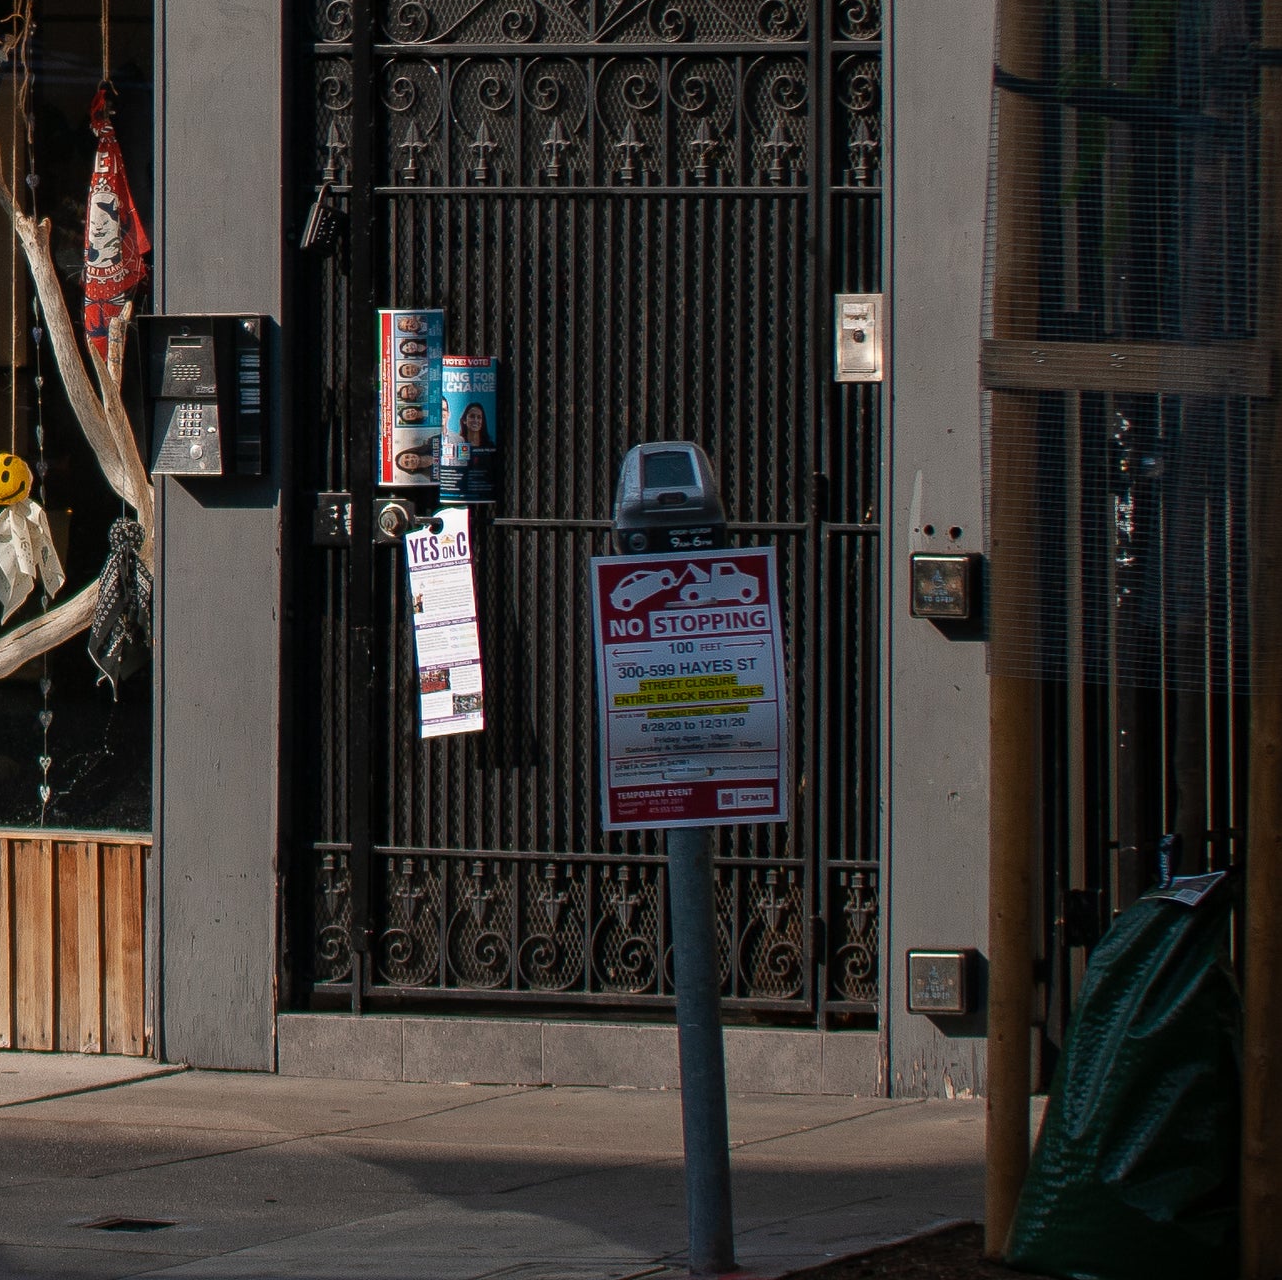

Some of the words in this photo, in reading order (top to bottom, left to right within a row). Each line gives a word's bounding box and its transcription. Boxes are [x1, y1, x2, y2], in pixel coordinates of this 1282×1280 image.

[473, 372, 495, 382] FOR
[446, 382, 496, 392] CHANGE
[409, 535, 439, 563] YES
[442, 545, 455, 559] ON
[456, 531, 467, 556] C
[609, 618, 644, 637] NO
[654, 610, 766, 634] STOPPING
[668, 641, 693, 654] 100
[700, 642, 721, 651] FEET
[618, 664, 675, 679] 300-599
[680, 659, 732, 674] HAYES
[737, 657, 757, 671] ST
[639, 680, 681, 692] STREET
[685, 675, 738, 689] CLOSURE
[614, 693, 655, 705] ENTIRE
[657, 691, 695, 703] BLOCK
[699, 688, 728, 700] BOTH
[732, 686, 764, 698] SIDES
[641, 722, 681, 732] 8/28/20
[684, 721, 696, 730] to
[699, 718, 745, 729] 12/31/20
[617, 789, 665, 800] TEMPORARY
[667, 787, 693, 796] EVENT
[740, 794, 769, 802] SFMTA
